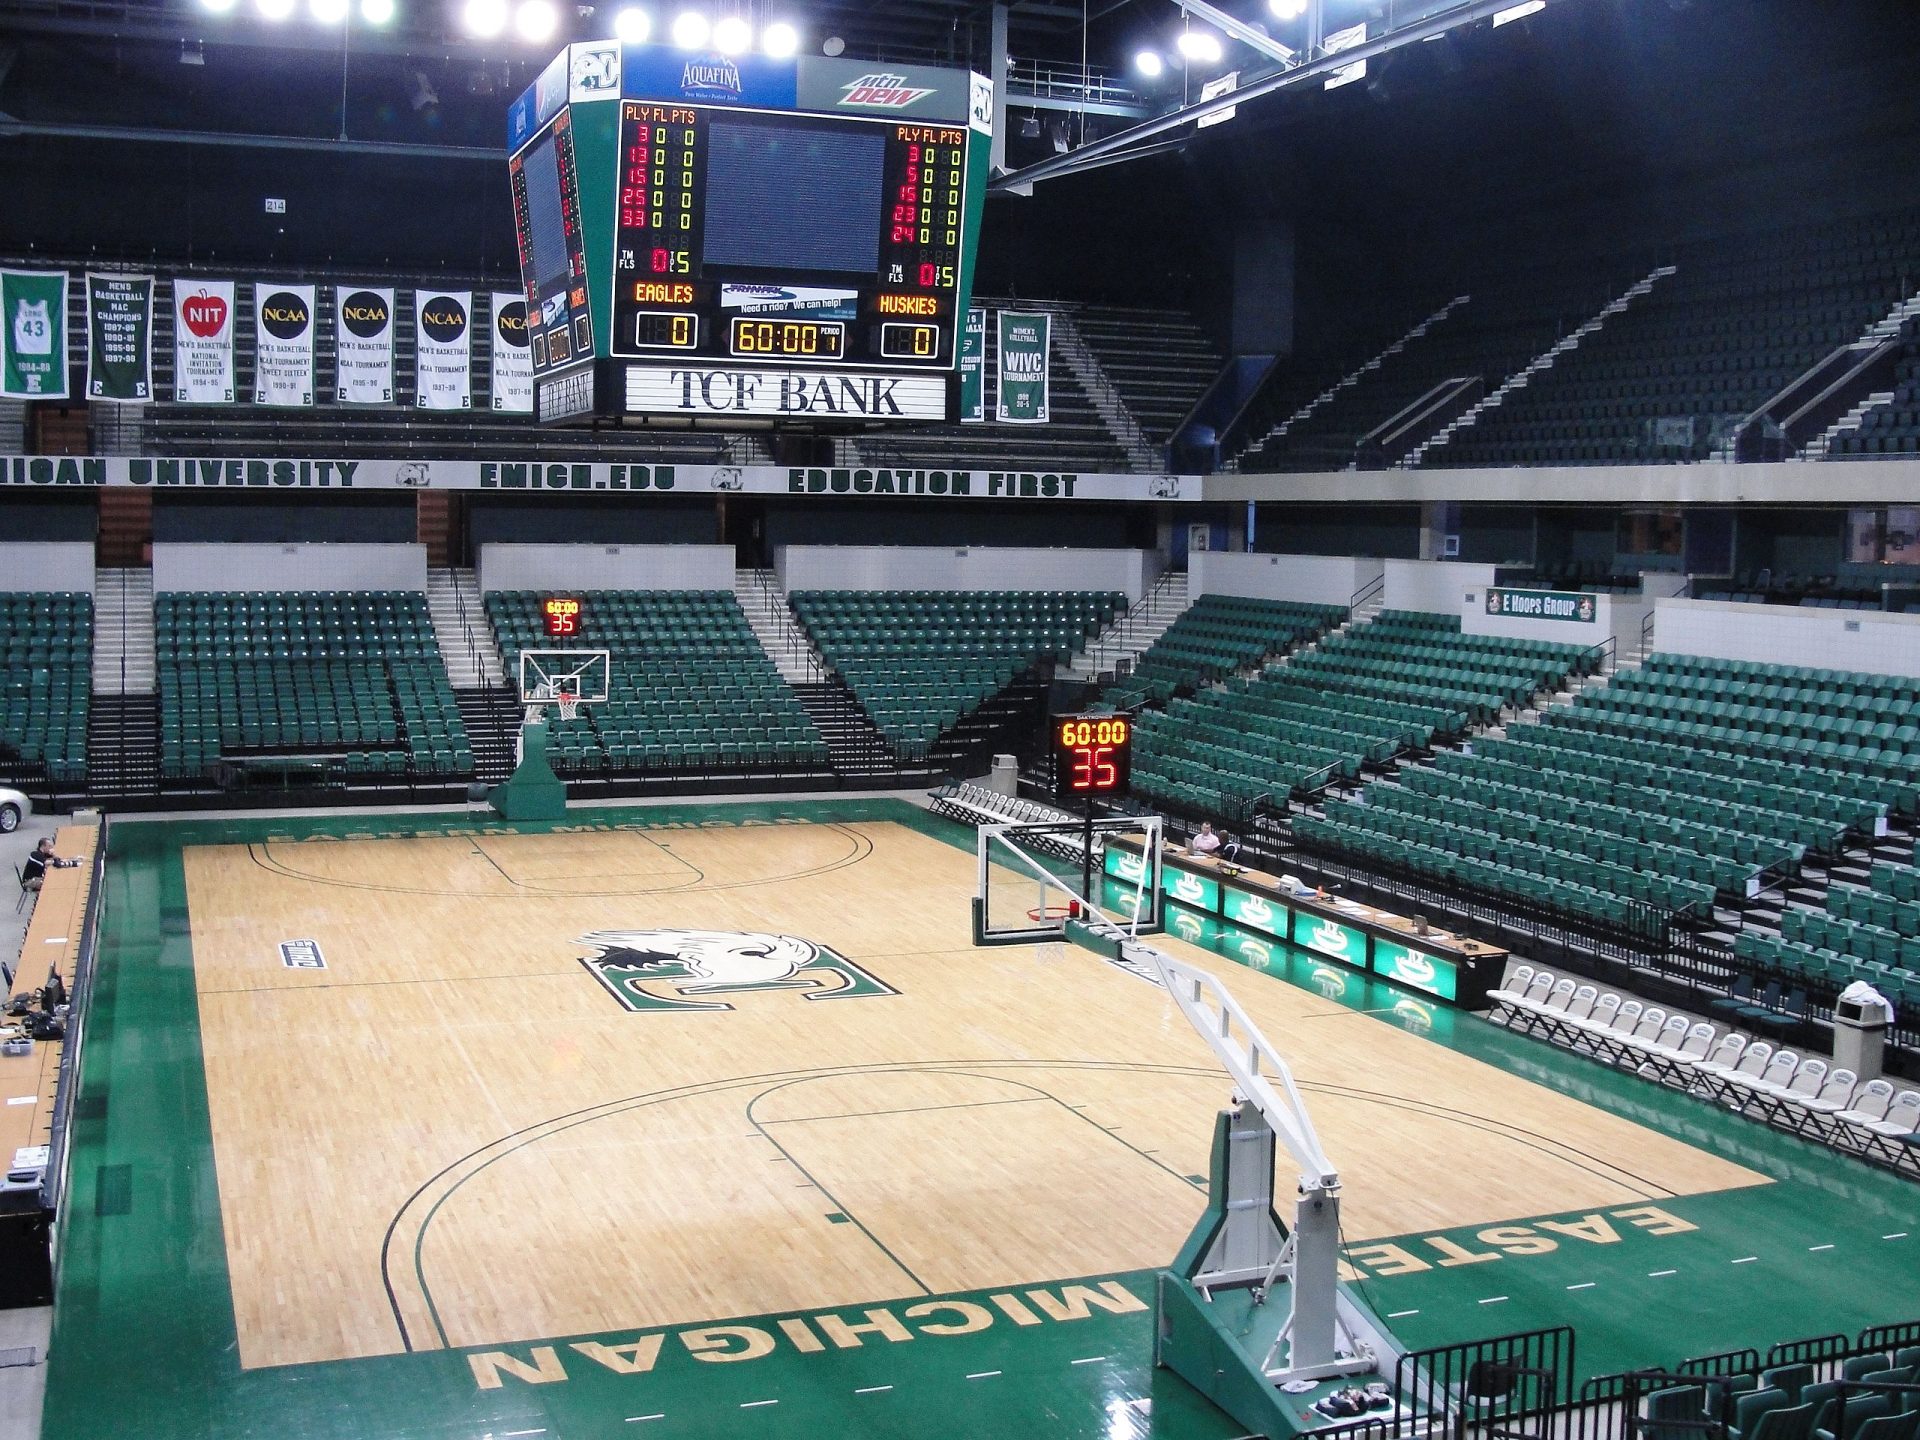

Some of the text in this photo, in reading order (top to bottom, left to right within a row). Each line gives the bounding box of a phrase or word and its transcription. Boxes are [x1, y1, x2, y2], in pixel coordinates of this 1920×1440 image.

[681, 61, 741, 92] AQUAFINA
[626, 106, 695, 125] PLY FL PTS
[640, 126, 694, 146] 3 0 0
[898, 127, 962, 145] PLY FL PTS
[632, 147, 693, 167] 13 0 0
[909, 146, 960, 166] 3 0 0
[631, 169, 692, 187] 15 0 0
[924, 168, 933, 184] 0
[950, 170, 959, 186] 0
[267, 201, 284, 210] 214
[624, 188, 691, 208] 25 0 0
[901, 187, 958, 206] 15 0 0
[623, 210, 690, 229] 33 0 0
[894, 206, 957, 225] 23 0 0
[893, 226, 956, 245] 24 0 0
[619, 259, 635, 269] FLS
[622, 250, 633, 260] TM
[653, 248, 667, 272] 0
[677, 251, 689, 273] 5
[888, 273, 904, 283] FLS
[891, 264, 902, 274] TM
[919, 263, 934, 286] 0
[942, 266, 954, 287] 5
[95, 290, 144, 300] BASKETBALL
[636, 283, 693, 303] EAGLES
[111, 303, 128, 311] MAC
[264, 307, 306, 322] NCAA
[344, 307, 387, 320] NCAA
[741, 299, 842, 313] Need a ride? We can help!
[880, 296, 937, 315] HUSKIES
[97, 311, 142, 321] CHAMPIONS
[189, 307, 222, 323] NIT
[424, 312, 464, 325] NCAA
[500, 317, 528, 330] NCA
[23, 320, 43, 336] 43
[672, 317, 688, 345] 0
[820, 327, 840, 335] PERIOD
[1012, 327, 1035, 335] WOMEN'S
[197, 341, 231, 350] BASKETBALL
[739, 323, 817, 353] 60:00
[831, 336, 836, 351] 1
[914, 328, 930, 355] 0
[1009, 334, 1038, 343] VOLLEYBALL
[189, 360, 222, 368] INVITATION
[191, 352, 219, 360] NATIONAL
[275, 358, 310, 366] TOURNAMENT
[355, 361, 389, 369] TOURNAMENT
[512, 352, 531, 360] BASKE
[1005, 351, 1042, 372] WIVC
[186, 368, 225, 376] TOURNAMENT
[434, 365, 468, 373] TOURNAMENT
[1003, 371, 1044, 382] TOURNAMENT
[670, 371, 904, 415] TCF BANK
[129, 459, 359, 486] UNIVERSITY
[480, 463, 675, 490] EMICH.EDU
[788, 468, 1077, 497] EDUCATION FIRST
[547, 602, 578, 614] 60:00
[1503, 594, 1576, 616] E HOOPS GROUP
[553, 613, 573, 631] 35
[1062, 721, 1125, 746] 60:00
[1074, 747, 1114, 786] 35
[466, 1205, 1701, 1390] MICHIGAN EASTE
